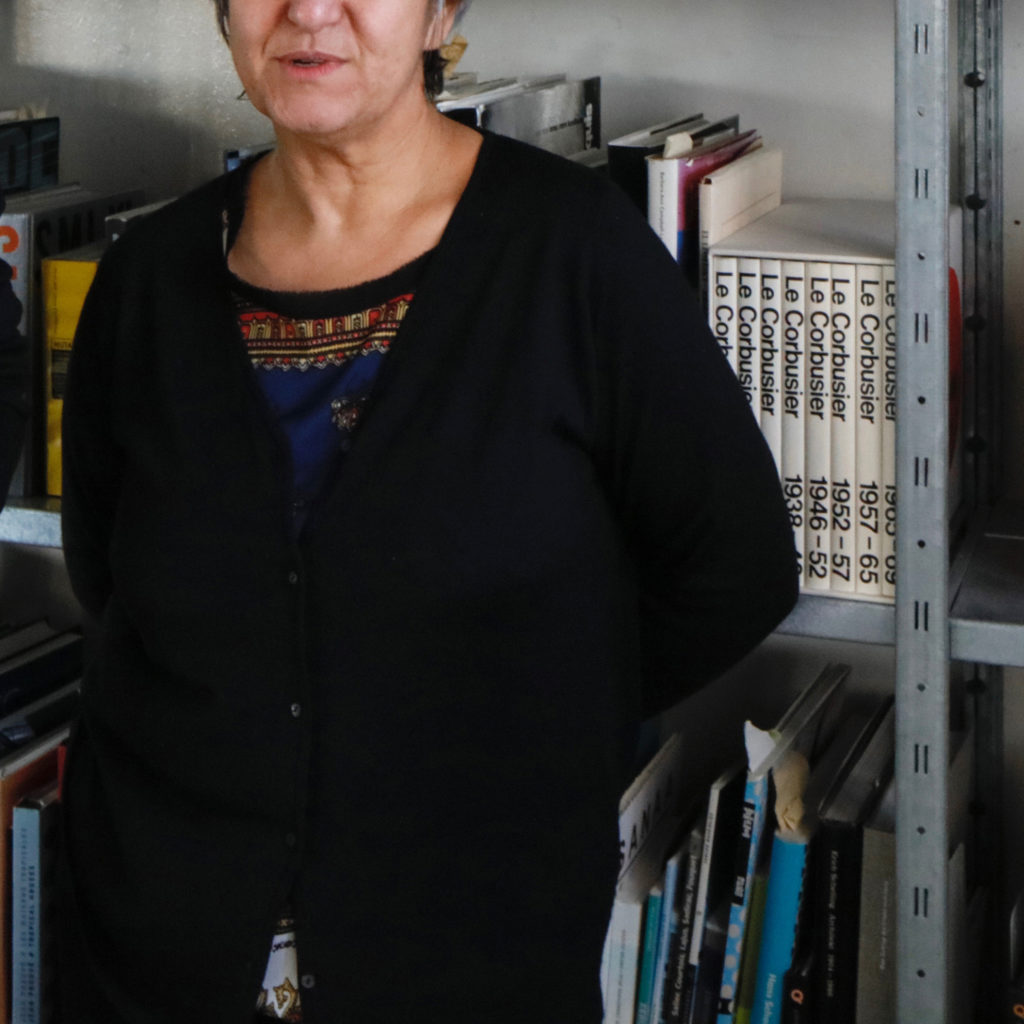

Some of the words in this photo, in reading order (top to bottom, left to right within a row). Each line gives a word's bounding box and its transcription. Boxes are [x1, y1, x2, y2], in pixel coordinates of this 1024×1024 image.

[715, 271, 733, 298] Le
[738, 272, 757, 298] Le
[761, 274, 779, 300] Le
[784, 275, 804, 302] Le
[809, 277, 829, 304] Le
[831, 278, 851, 305] Le
[860, 280, 880, 306] Le
[761, 307, 780, 416] Corbusier
[784, 309, 804, 418] Corbusier
[809, 310, 830, 420] Corbusier
[831, 312, 851, 422] Corbusier
[860, 313, 880, 424] Corbusier
